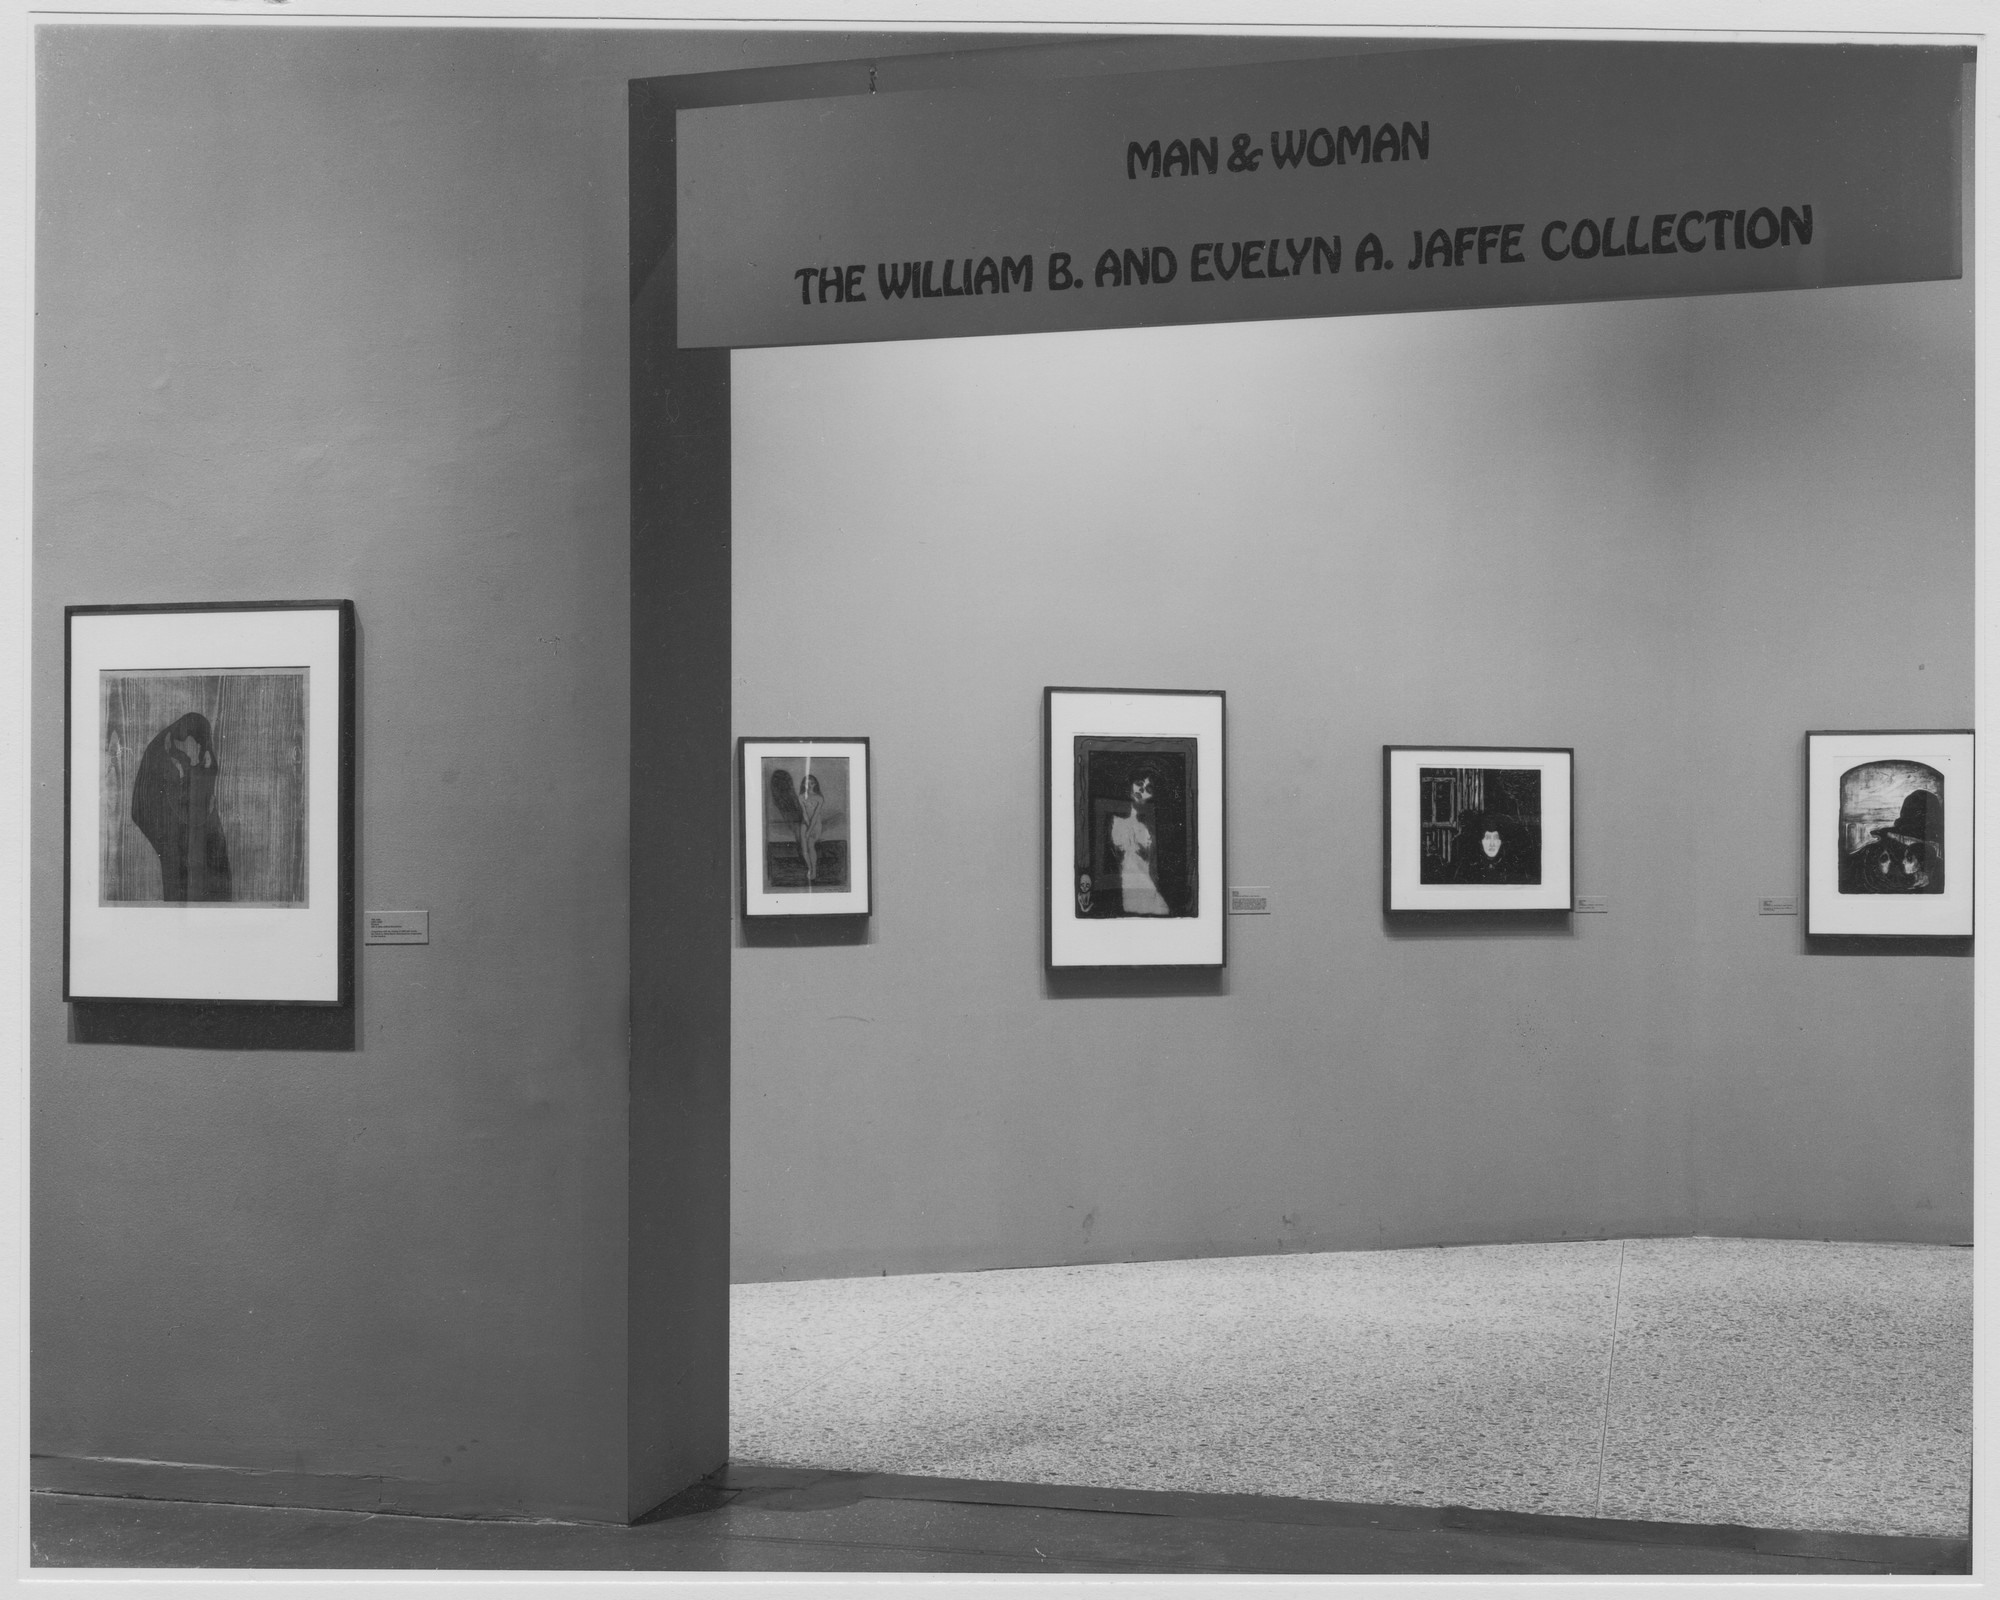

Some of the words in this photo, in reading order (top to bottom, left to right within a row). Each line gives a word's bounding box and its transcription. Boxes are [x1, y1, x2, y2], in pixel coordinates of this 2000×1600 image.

[1127, 136, 1218, 179] MAN
[1227, 133, 1264, 174] &
[1271, 121, 1430, 169] WOMAN
[794, 265, 867, 305] THE
[878, 255, 1034, 301] WILLIAM
[1048, 252, 1084, 290] B.
[1095, 246, 1178, 288] AND
[1191, 235, 1342, 283] EVELYN
[1355, 233, 1394, 273] A.
[1408, 223, 1526, 270] JAFFE
[1542, 205, 1813, 262] COLLECTION
